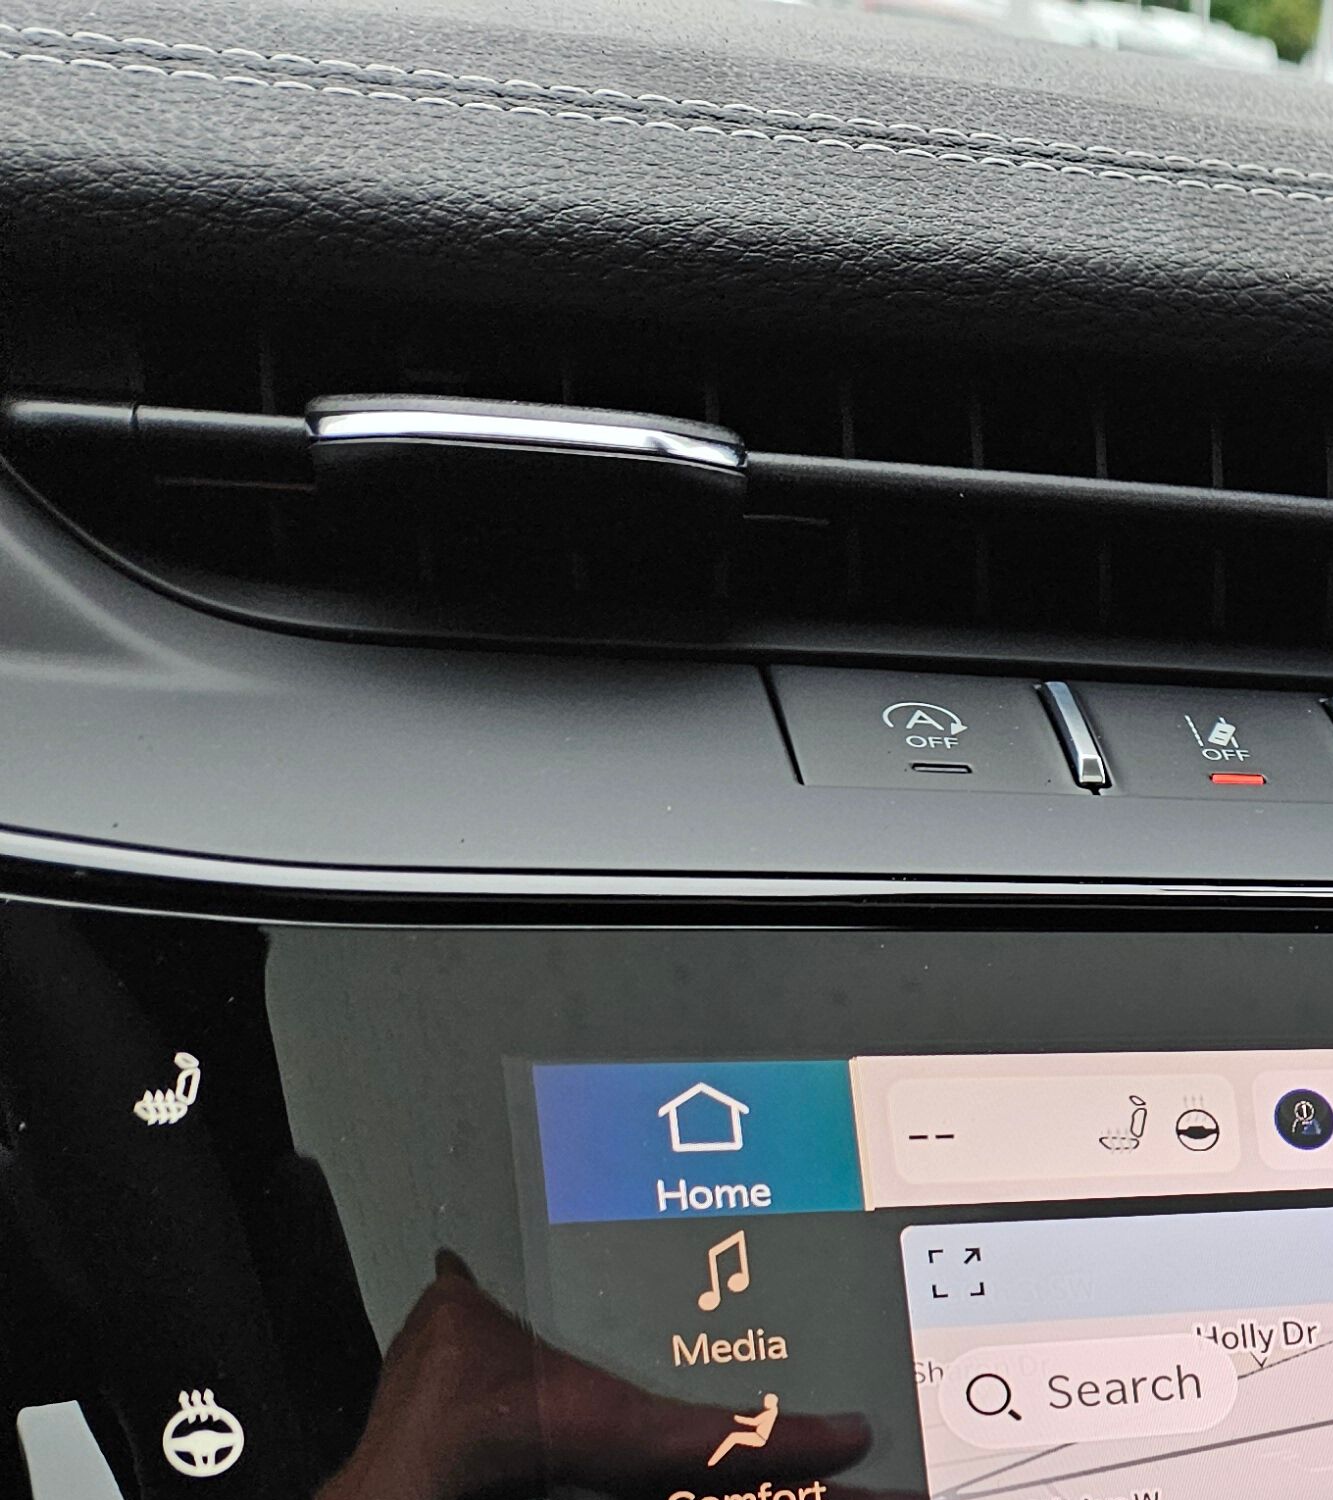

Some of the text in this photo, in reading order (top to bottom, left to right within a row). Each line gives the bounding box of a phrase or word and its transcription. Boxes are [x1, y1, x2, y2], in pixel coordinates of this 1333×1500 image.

[906, 734, 959, 750] OFF
[1202, 747, 1251, 762] OFF
[656, 1179, 773, 1213] Home
[672, 1329, 788, 1366] Media
[1283, 1321, 1317, 1346] Dr
[1049, 1365, 1202, 1409] Search
